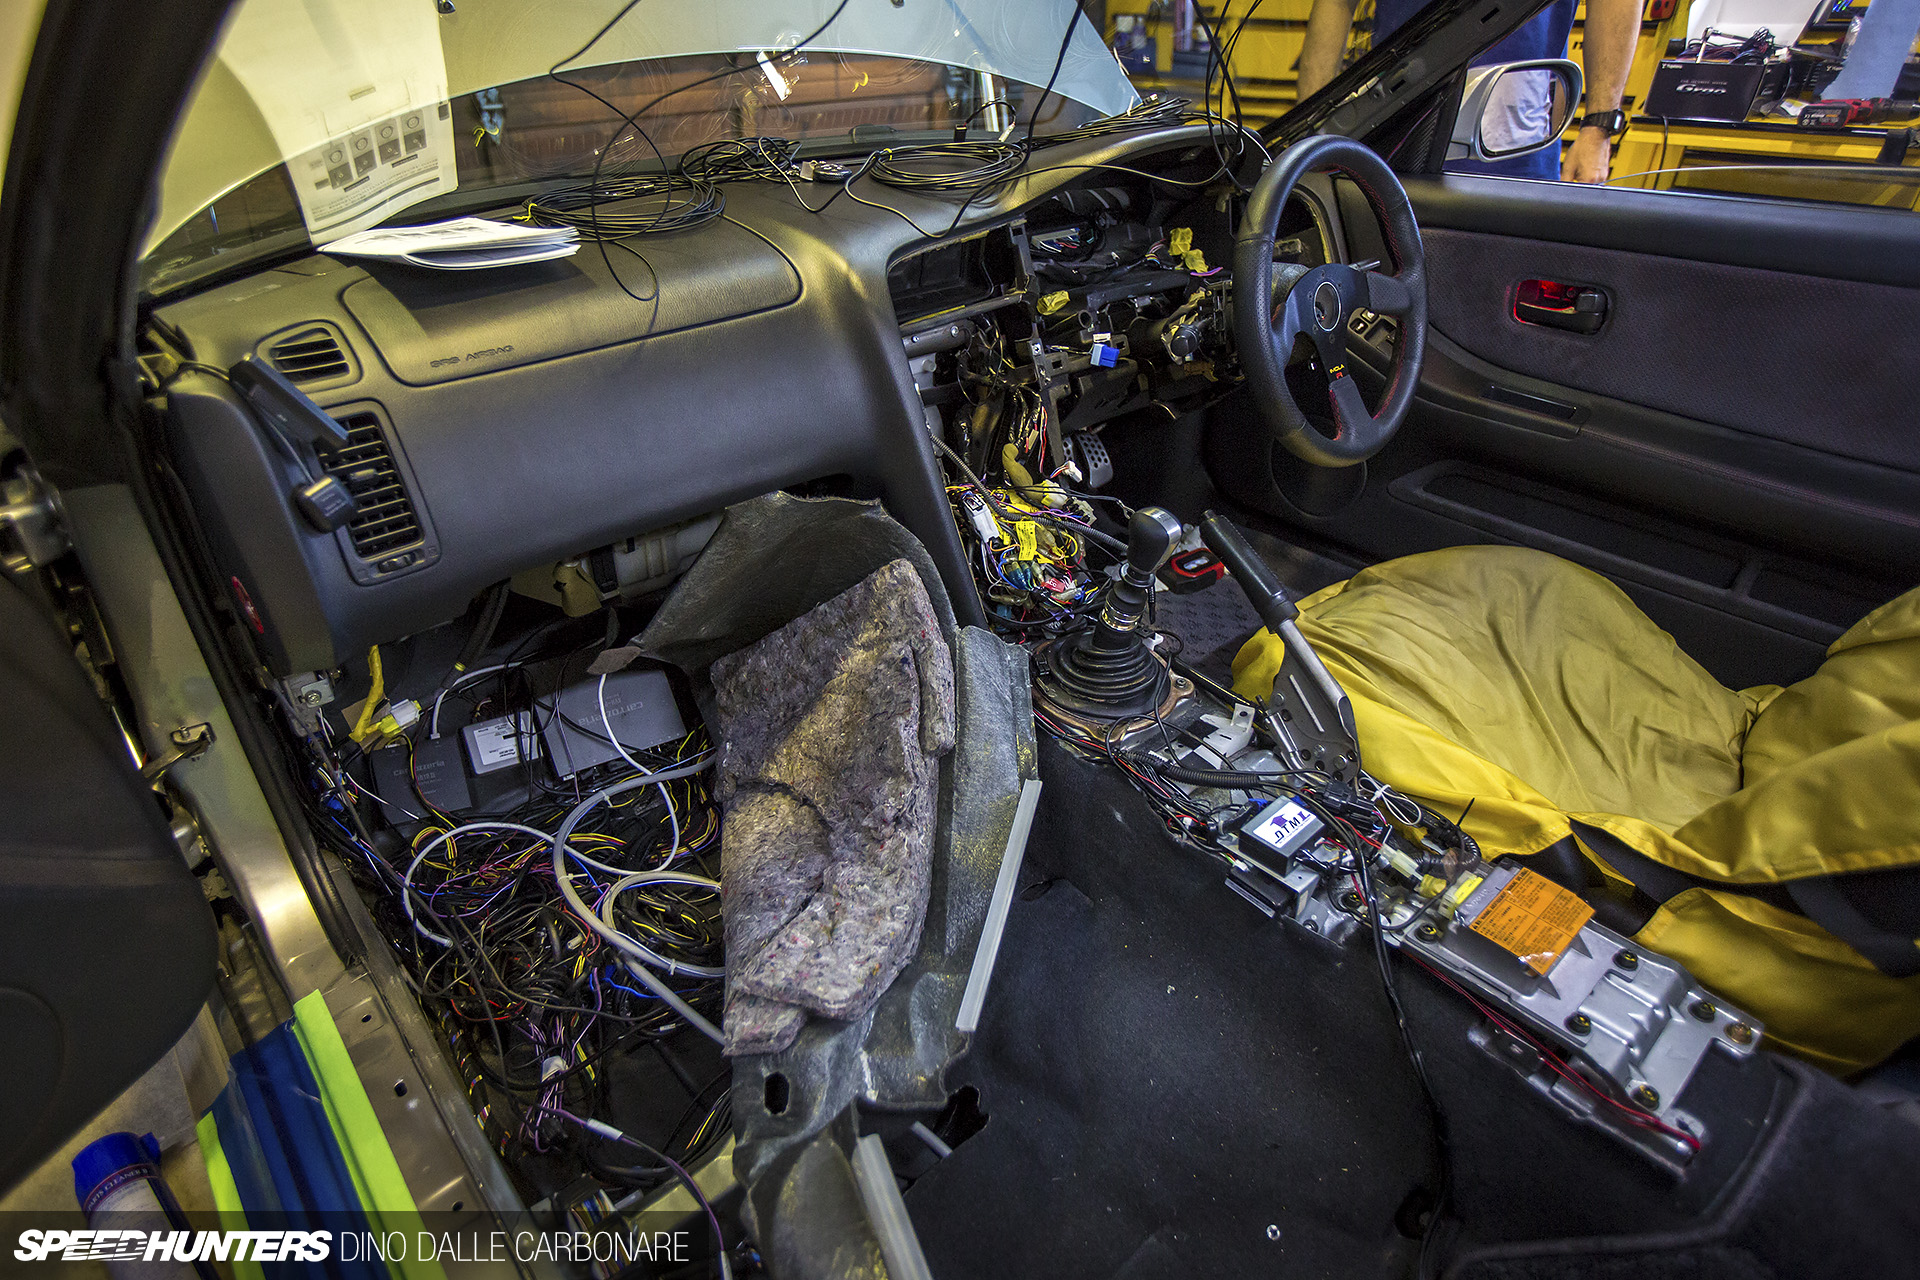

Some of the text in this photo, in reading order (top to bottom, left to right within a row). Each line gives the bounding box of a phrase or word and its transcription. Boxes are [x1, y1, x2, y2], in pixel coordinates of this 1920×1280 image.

[465, 344, 515, 361] AIRBAG
[578, 701, 643, 726] carrozeria
[393, 760, 446, 777] carozzeria
